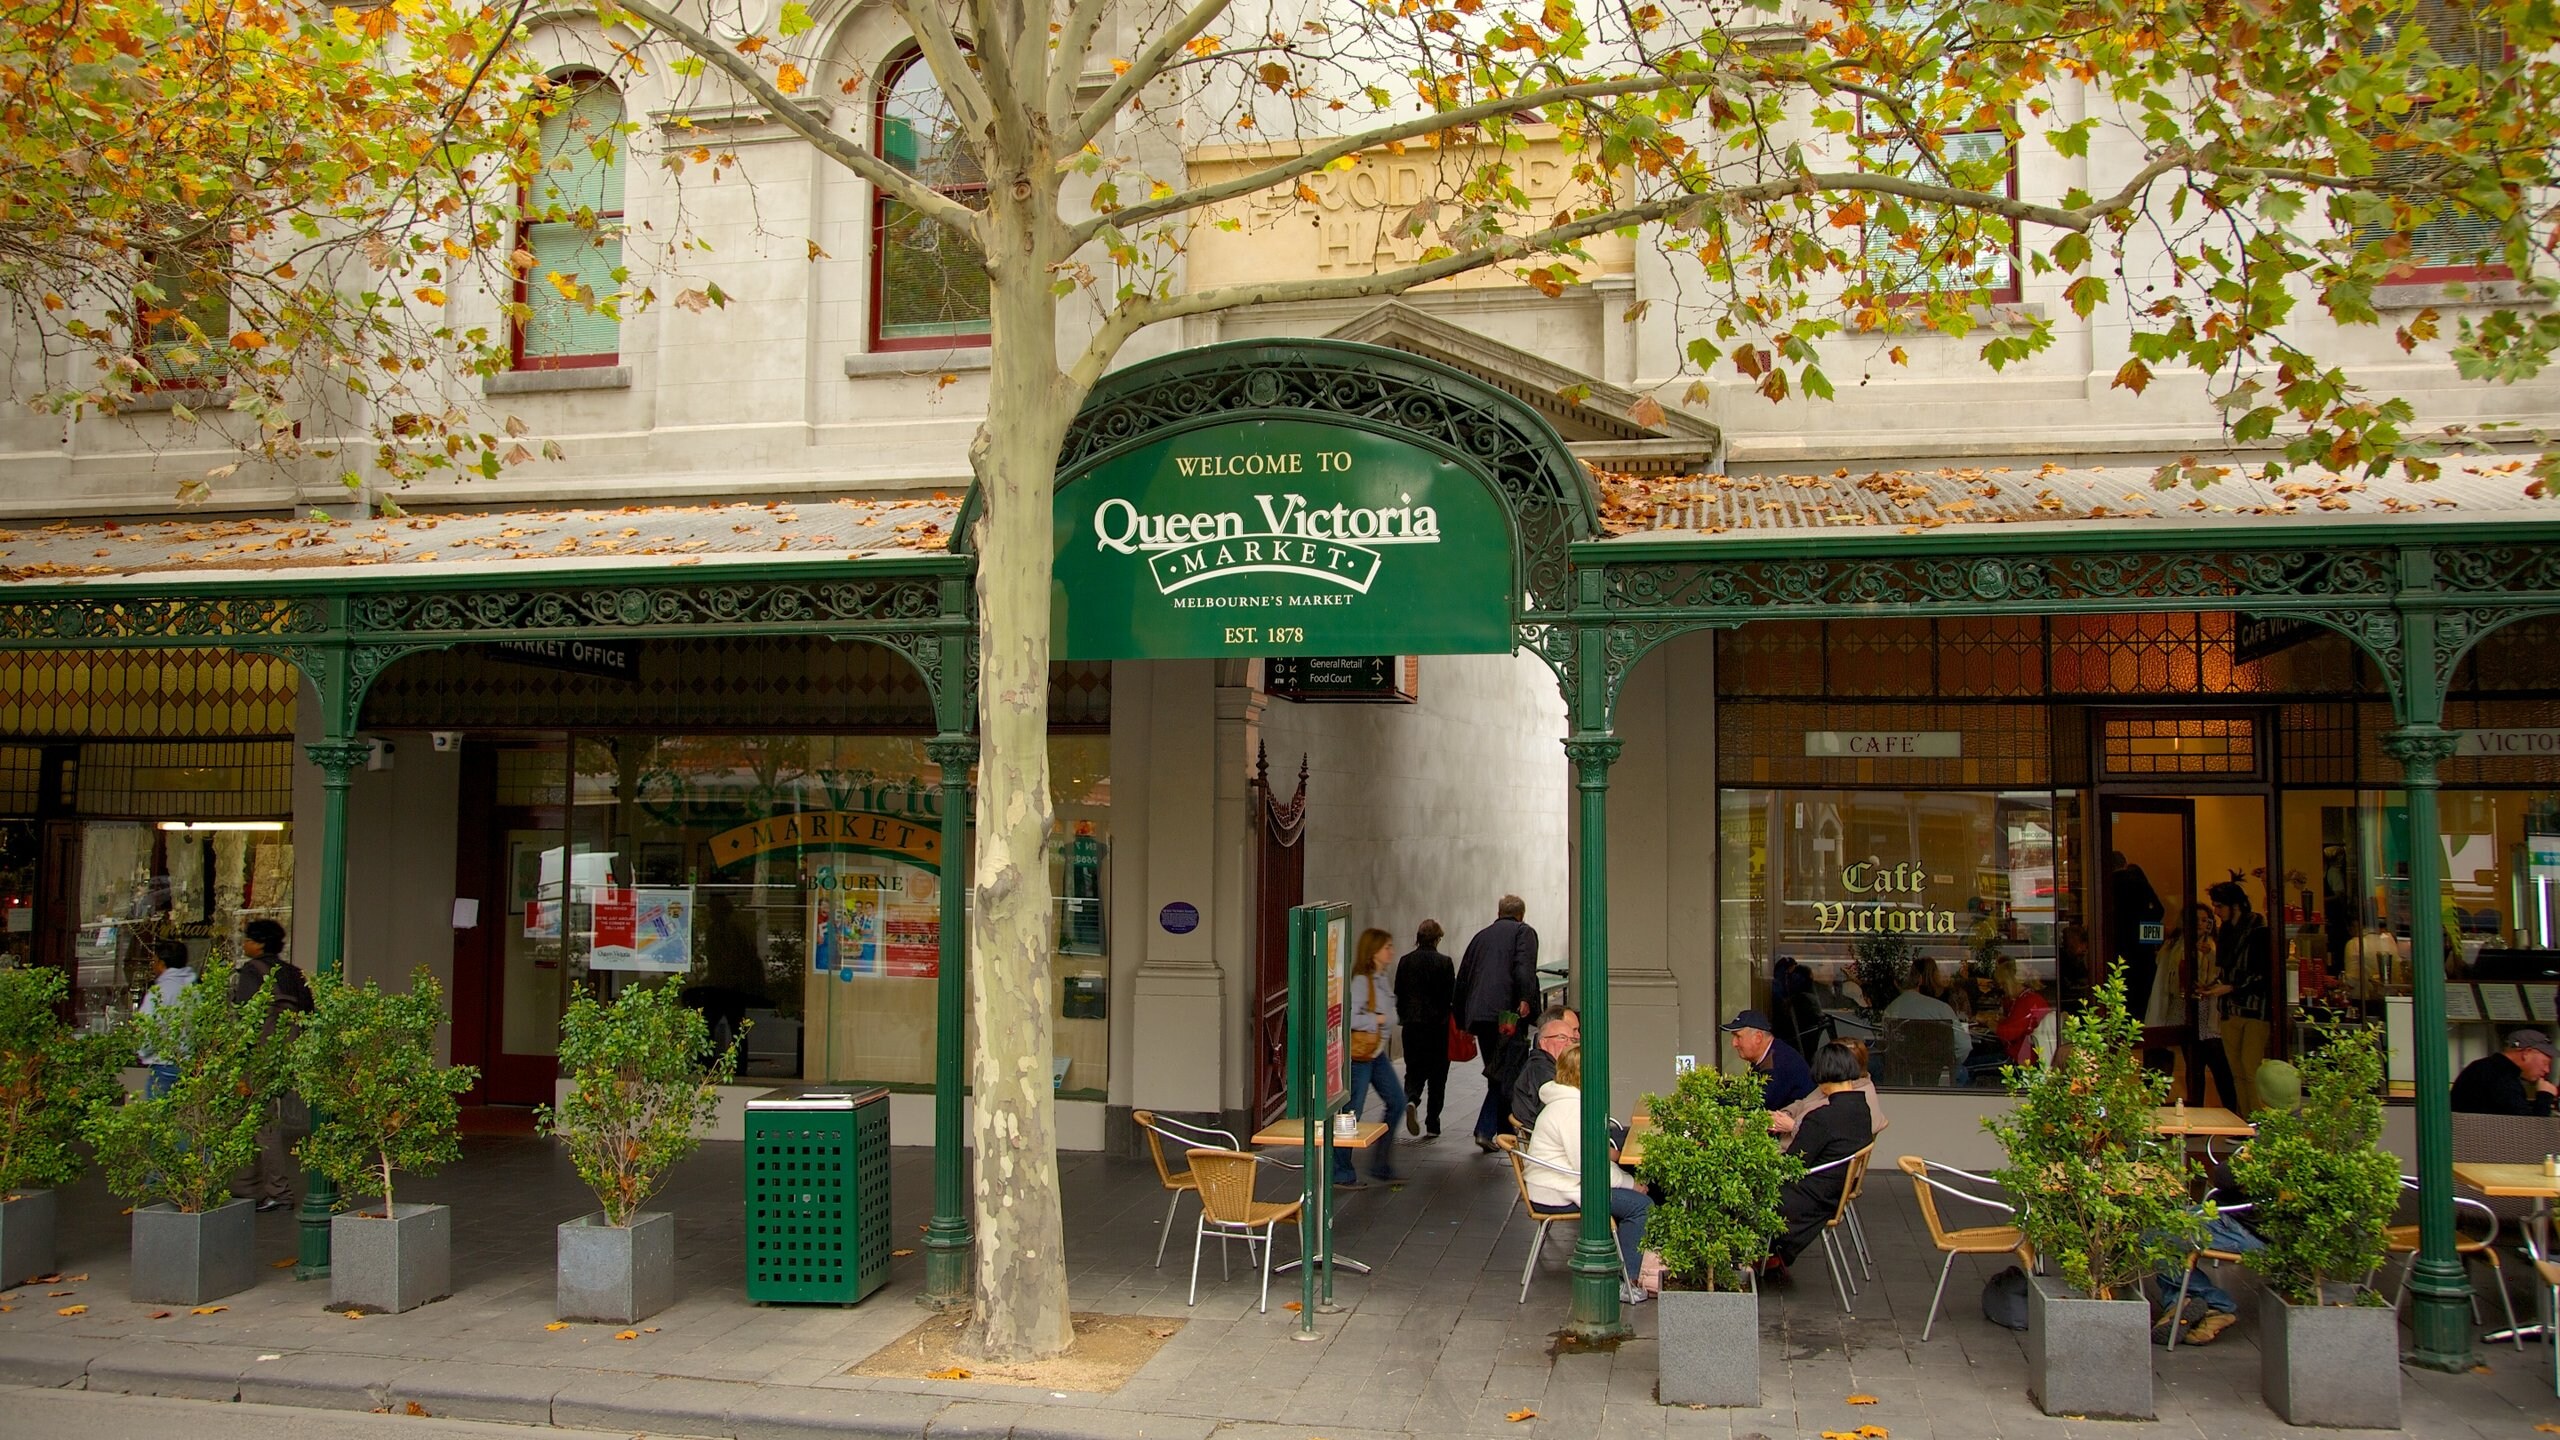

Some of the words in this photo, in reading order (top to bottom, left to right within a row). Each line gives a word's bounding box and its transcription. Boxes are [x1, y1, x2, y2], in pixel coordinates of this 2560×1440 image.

[1176, 453, 1303, 477] WELCOME
[1316, 451, 1353, 473] TO
[1093, 497, 1245, 555] Queen
[1253, 492, 1441, 539] Victoria
[1181, 540, 1347, 575] MARKET
[1173, 596, 1283, 608] MELBOURNE'S
[1288, 594, 1354, 606] MARKET
[1224, 627, 1259, 644] EST.
[1267, 627, 1304, 643] 1878
[572, 641, 626, 669] OFFICE
[1310, 658, 1340, 669] General
[1341, 658, 1363, 669] Retail
[1310, 673, 1330, 684] Food
[1330, 673, 1352, 684] Court
[750, 814, 916, 850] MARKET
[1840, 859, 1928, 894] Café
[1811, 902, 1958, 935] Victoria
[2143, 925, 2161, 939] OPEN
